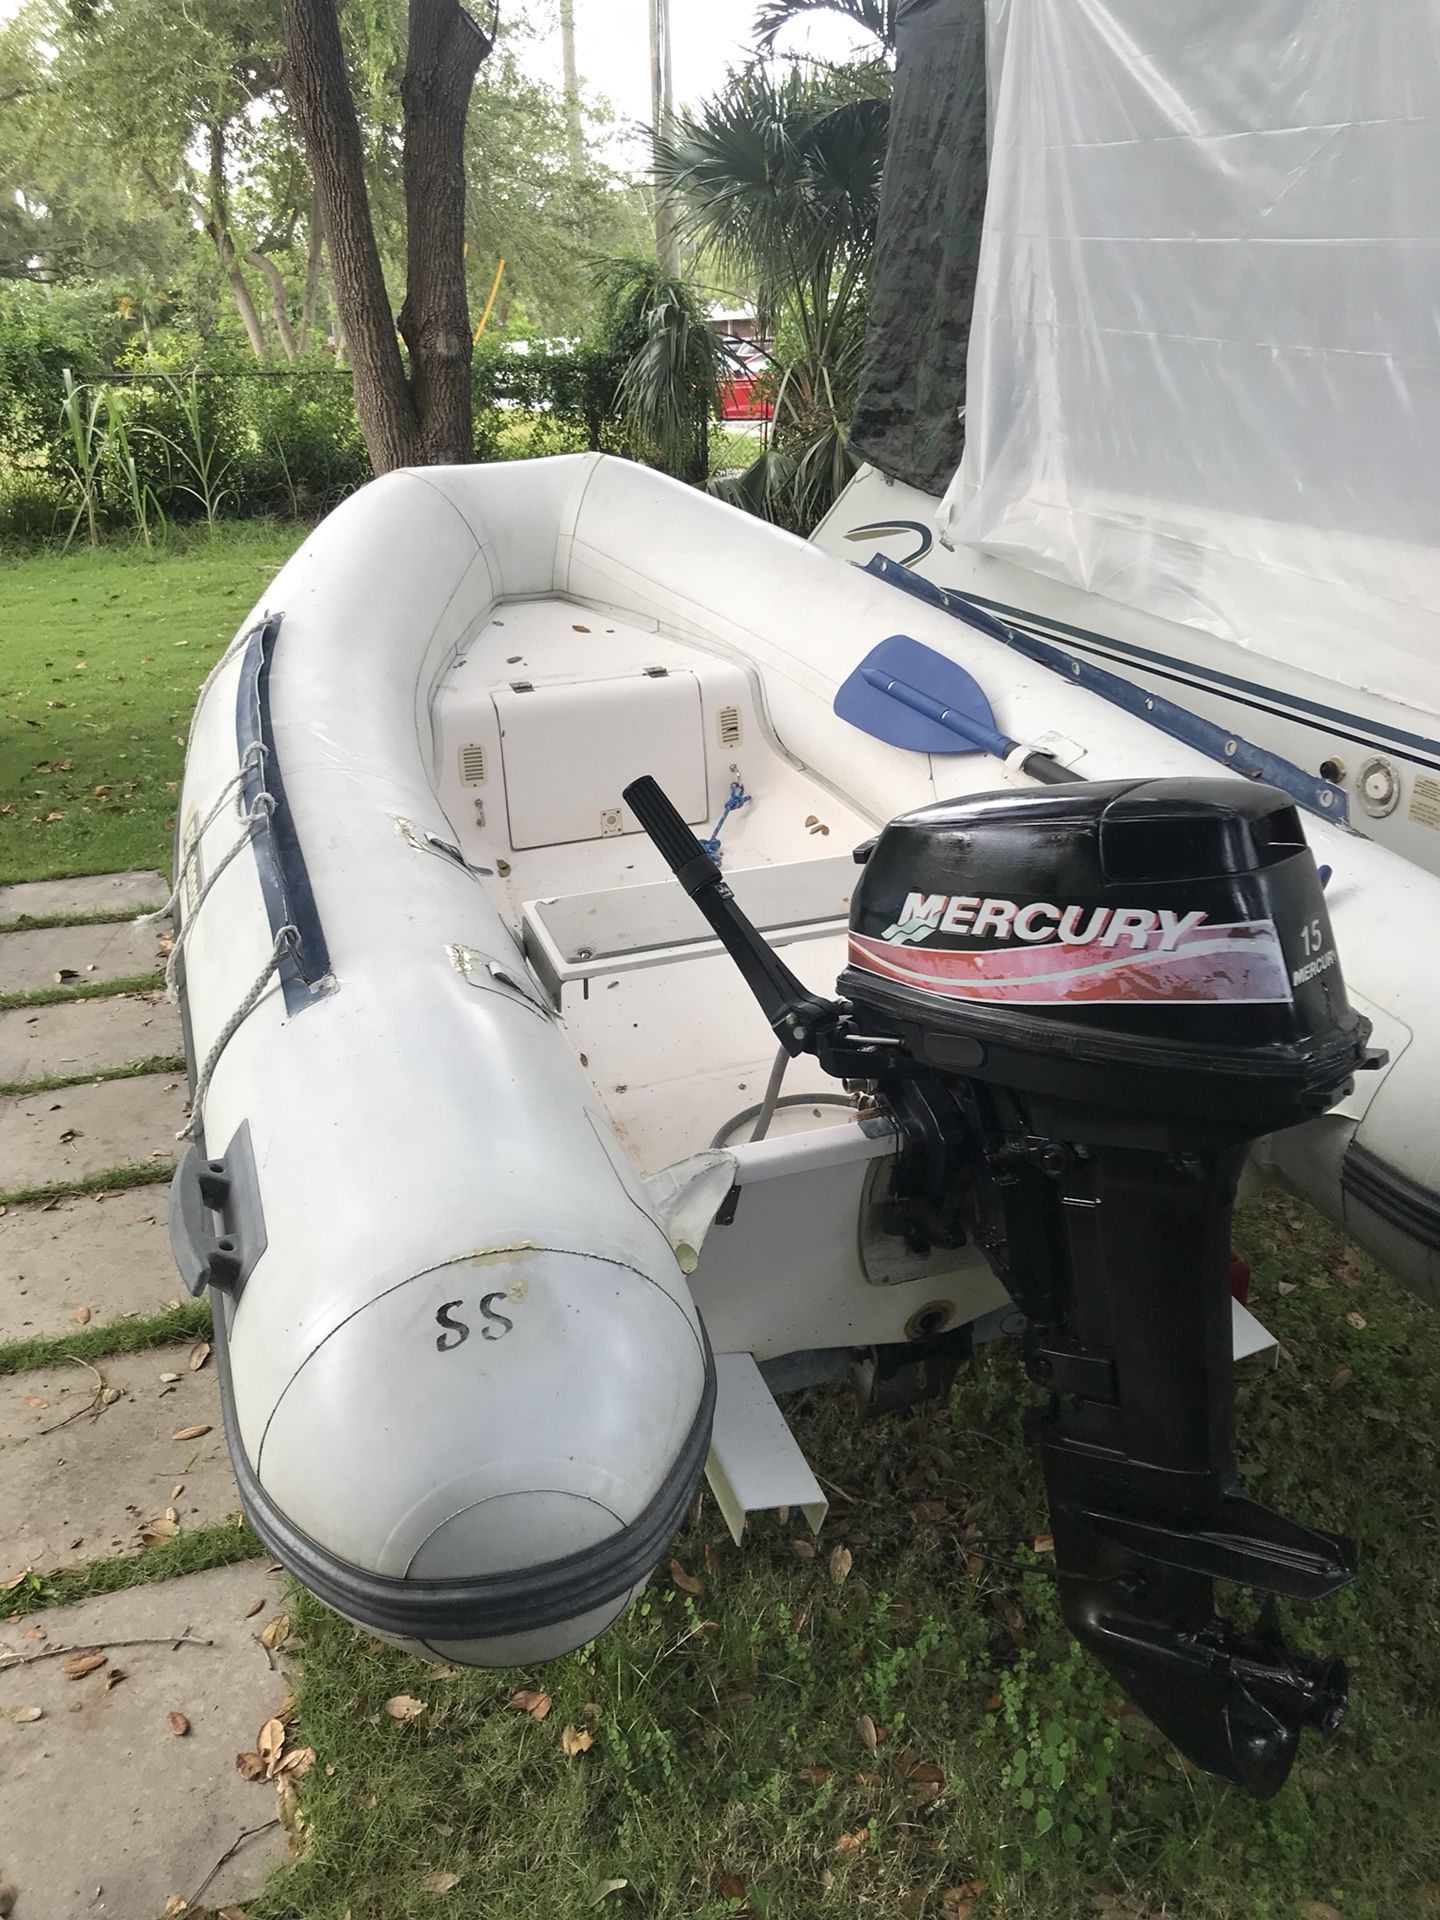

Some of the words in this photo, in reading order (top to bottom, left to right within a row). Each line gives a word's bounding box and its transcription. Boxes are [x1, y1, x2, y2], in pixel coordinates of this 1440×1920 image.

[895, 892, 1207, 951] MERCURY
[1301, 919, 1322, 956] 15
[1292, 950, 1336, 987] MERCUR
[435, 1291, 513, 1352] SS
